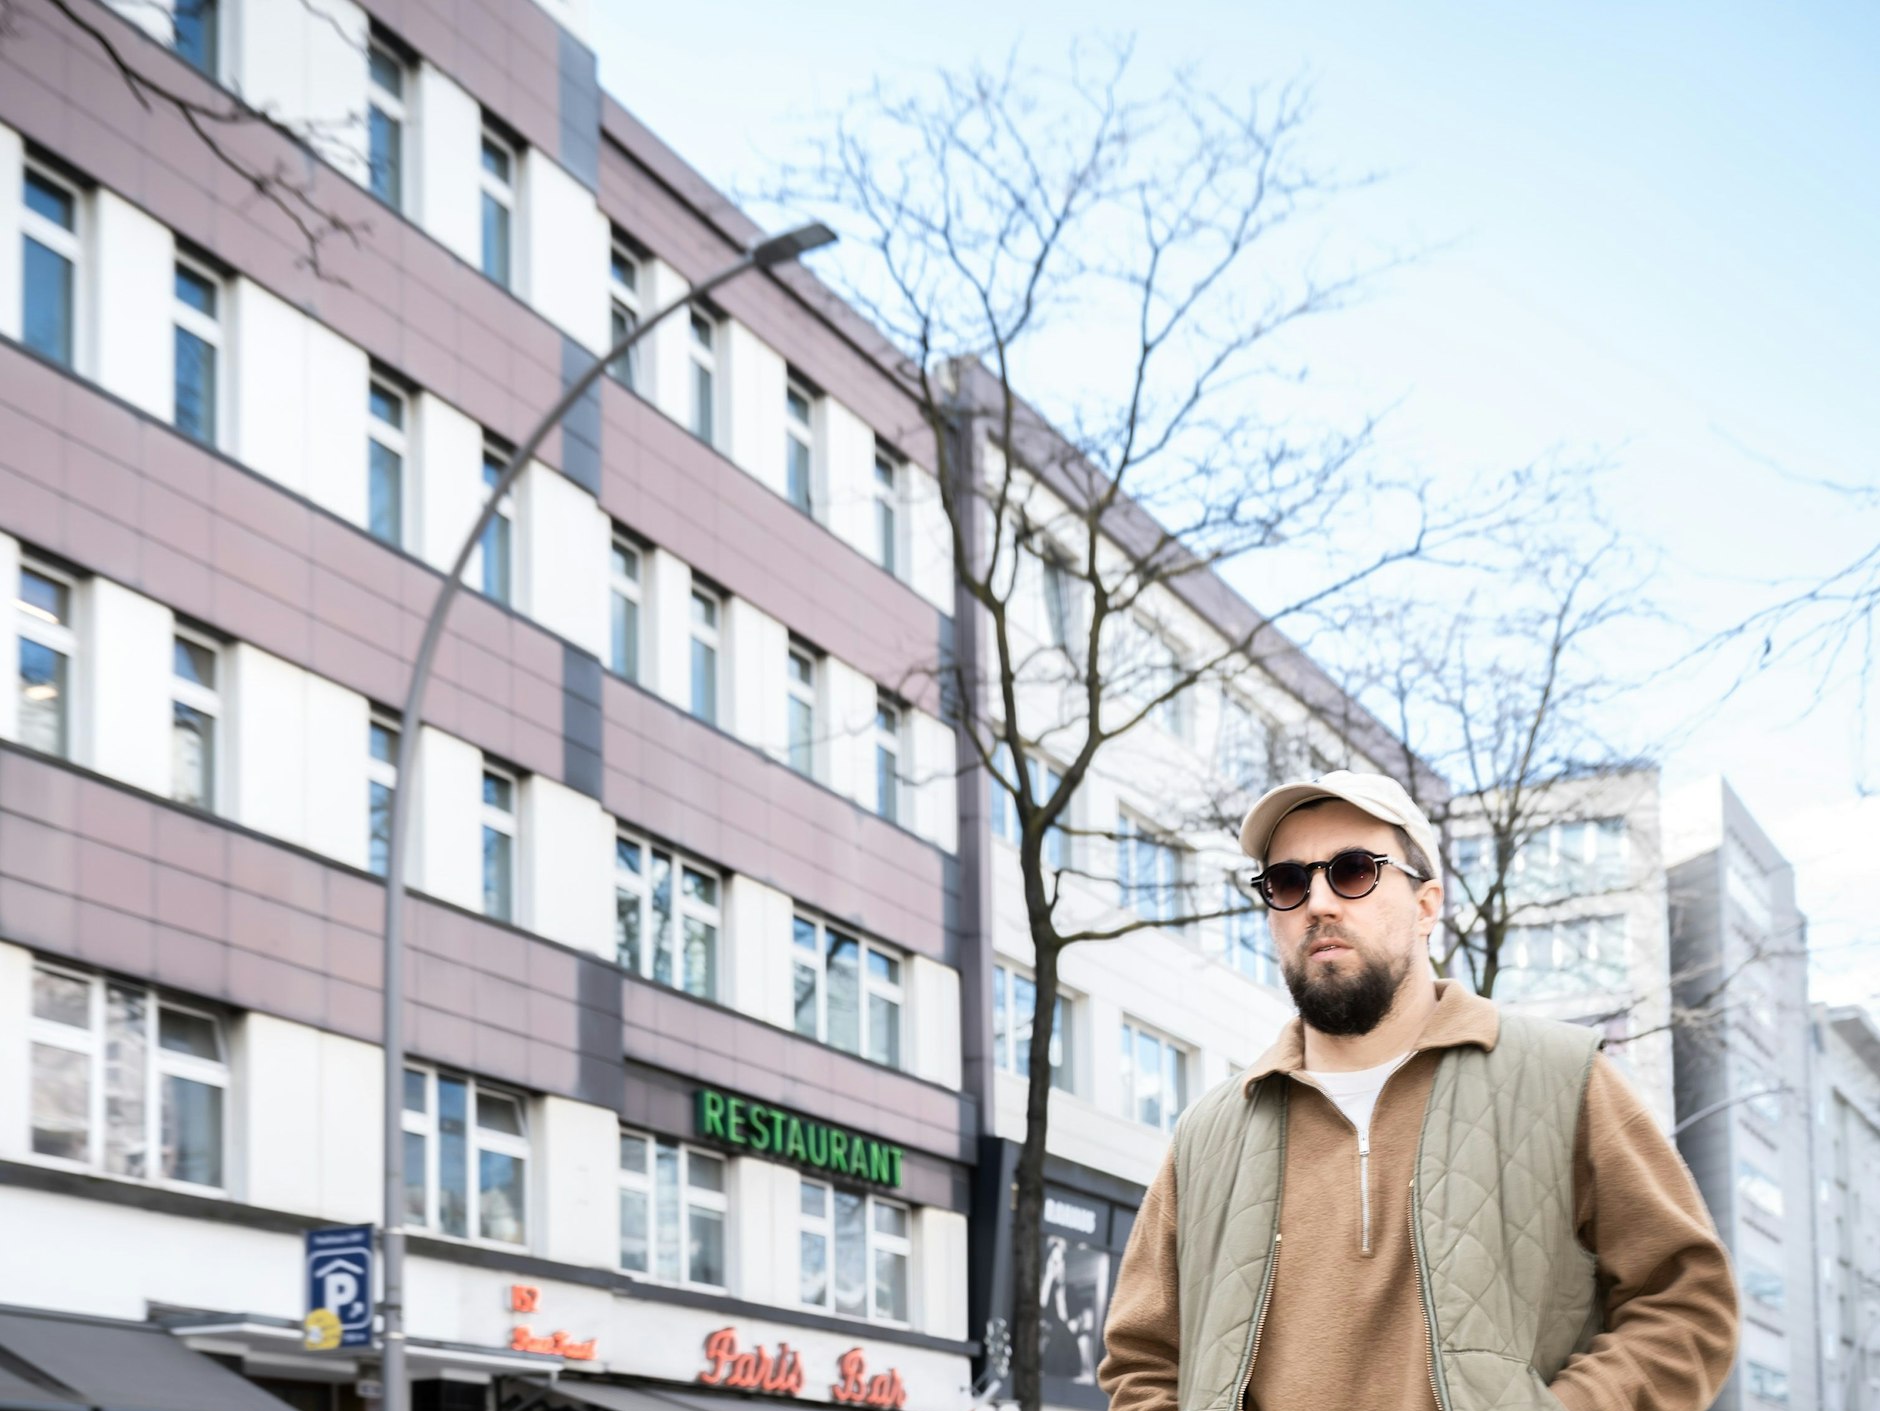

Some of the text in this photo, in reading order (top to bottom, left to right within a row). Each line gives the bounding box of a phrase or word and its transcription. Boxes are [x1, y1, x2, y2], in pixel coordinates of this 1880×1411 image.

[701, 1088, 904, 1188] RESTAURANT
[324, 1271, 359, 1318] P
[700, 1327, 906, 1409] Paris Bar
